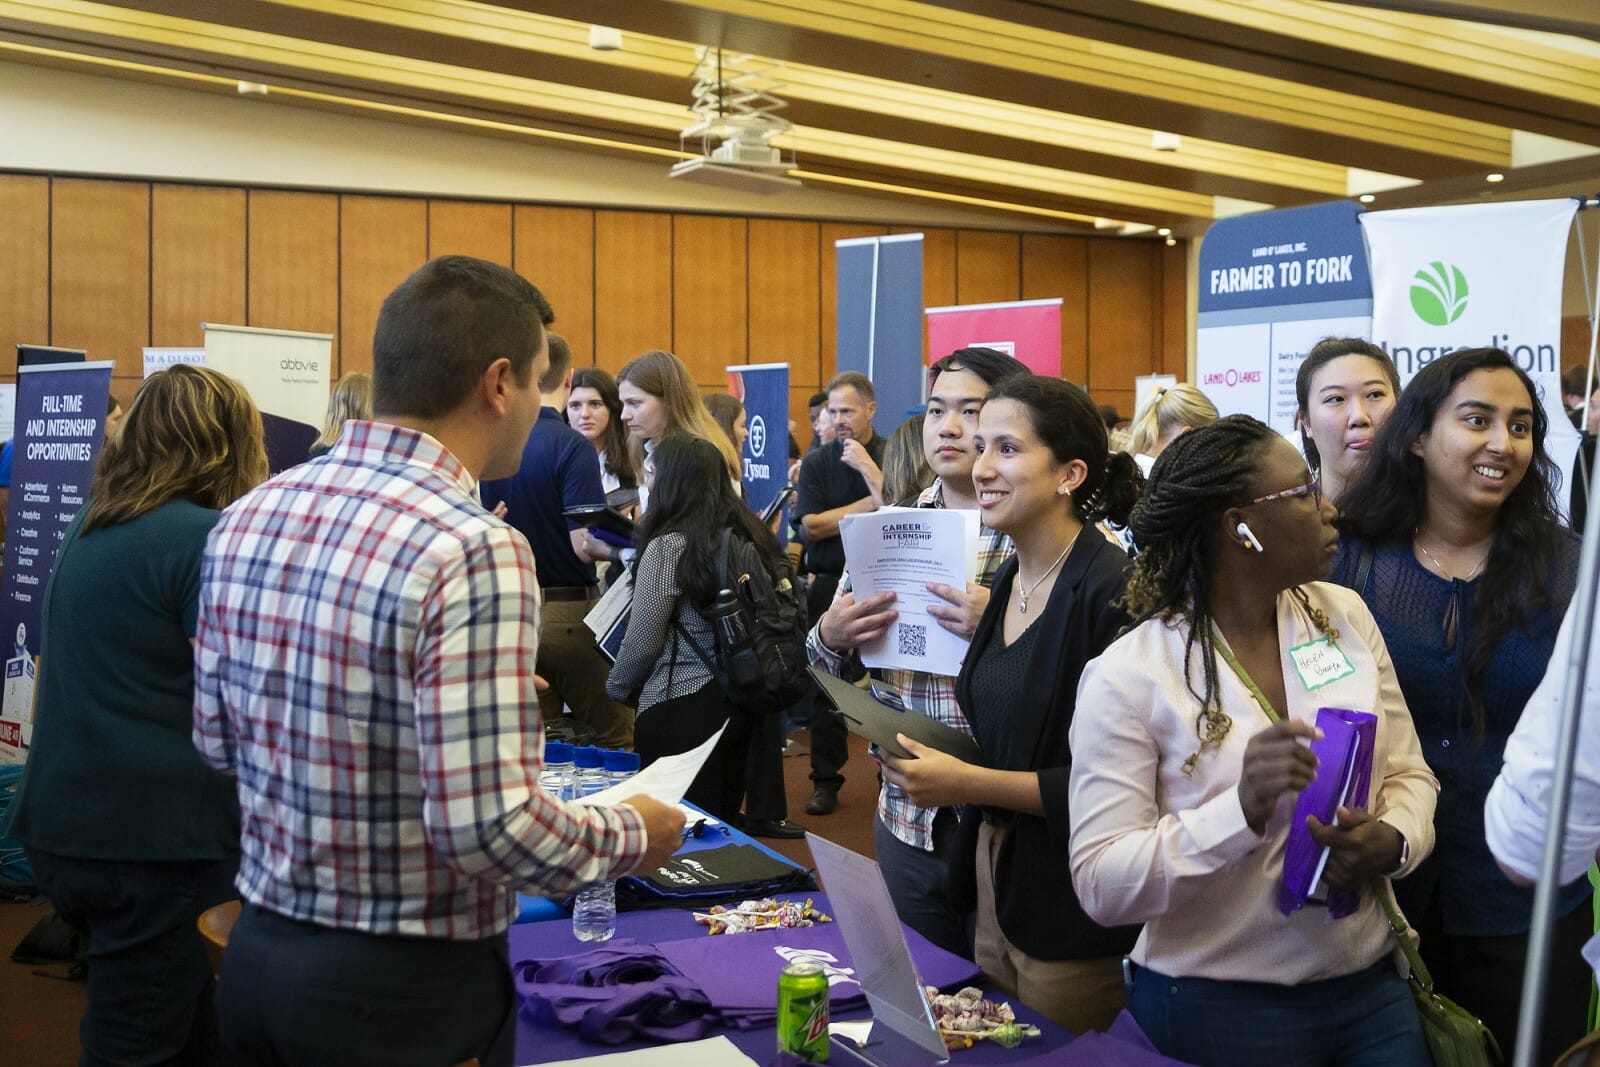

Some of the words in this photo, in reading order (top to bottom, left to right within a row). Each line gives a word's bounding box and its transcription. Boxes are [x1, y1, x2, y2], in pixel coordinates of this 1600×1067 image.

[1210, 263, 1275, 295] FARMER
[1279, 260, 1302, 288] TO
[1305, 255, 1353, 286] FORK
[145, 354, 206, 363] MADISO
[280, 358, 319, 372] abbvie
[1204, 373, 1224, 385] LAND
[1239, 370, 1262, 383] LAKES
[42, 394, 83, 413] FULL-TIME
[25, 419, 46, 437] AND
[46, 418, 97, 437] INTERNSHIP
[26, 442, 91, 461] OPPORTUNITIES
[743, 457, 770, 482] Tyson
[61, 483, 78, 494] Human
[24, 492, 50, 503] eCommerce
[61, 494, 83, 505] Resources
[22, 510, 41, 521] Analytics
[20, 528, 39, 538] Creative
[882, 523, 921, 532] CAREER
[883, 533, 932, 541] INTERNSHIP
[899, 540, 920, 548] FAIR
[19, 545, 39, 556] Customer
[18, 556, 33, 566] Service
[16, 574, 39, 585] Distribution
[15, 591, 32, 602] Finance
